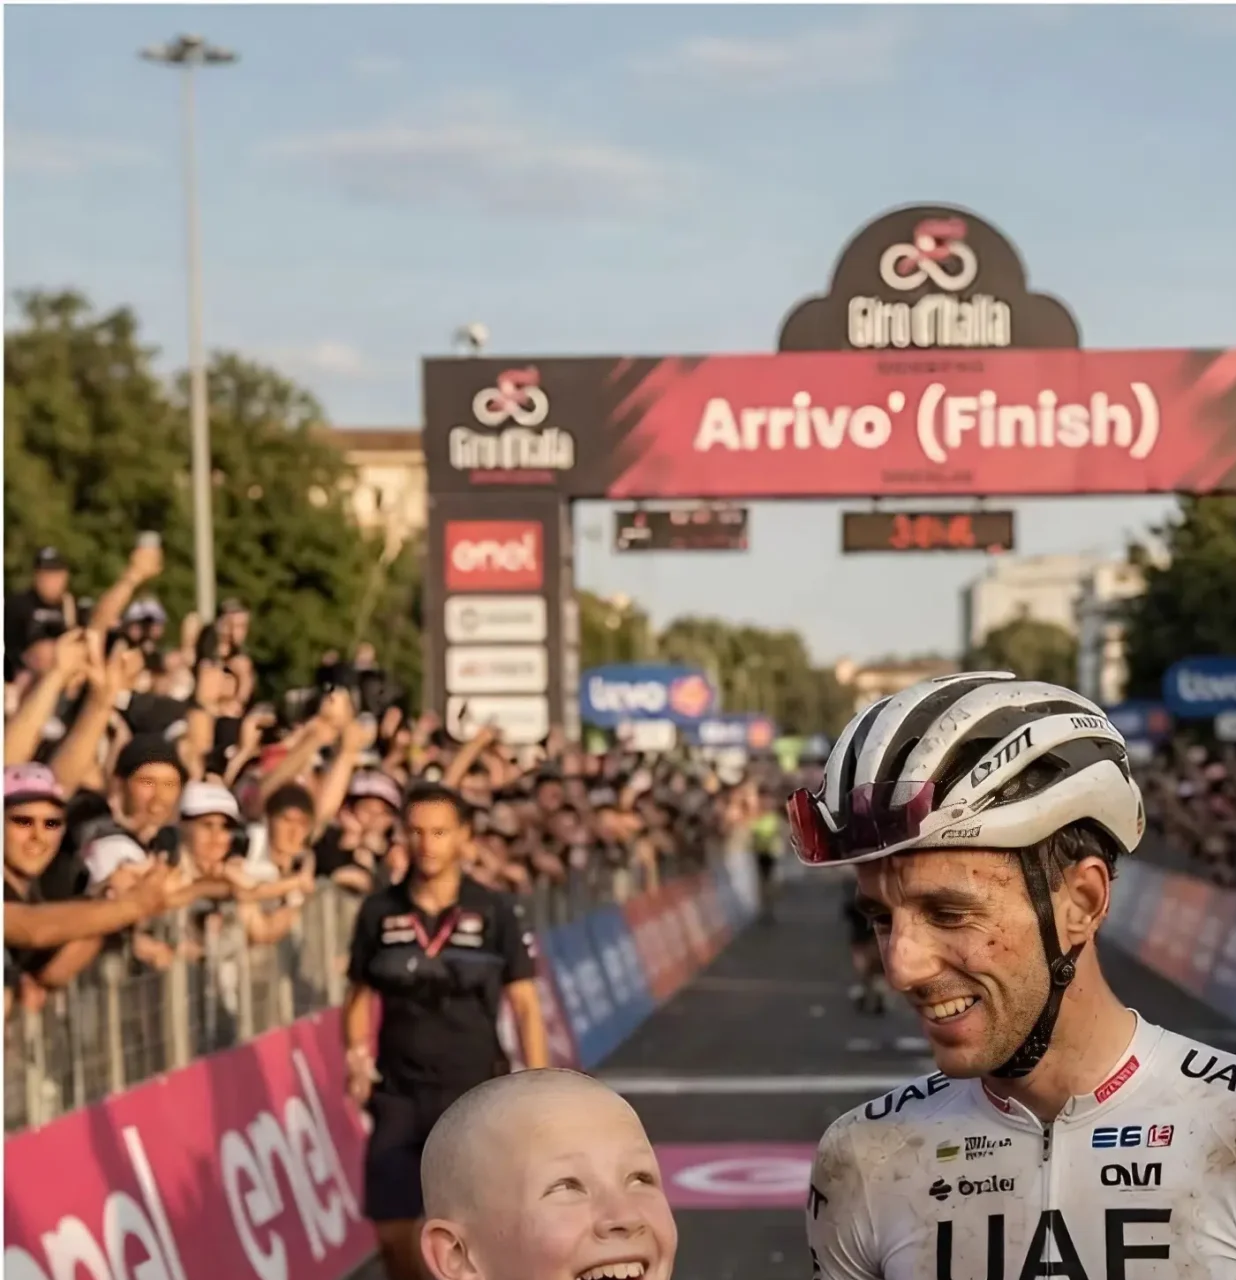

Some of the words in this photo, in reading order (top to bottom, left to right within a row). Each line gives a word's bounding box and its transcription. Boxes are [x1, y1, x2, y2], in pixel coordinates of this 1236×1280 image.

[917, 382, 1160, 463] (Finish)
[451, 529, 538, 573] enel
[864, 1070, 951, 1121] UAE
